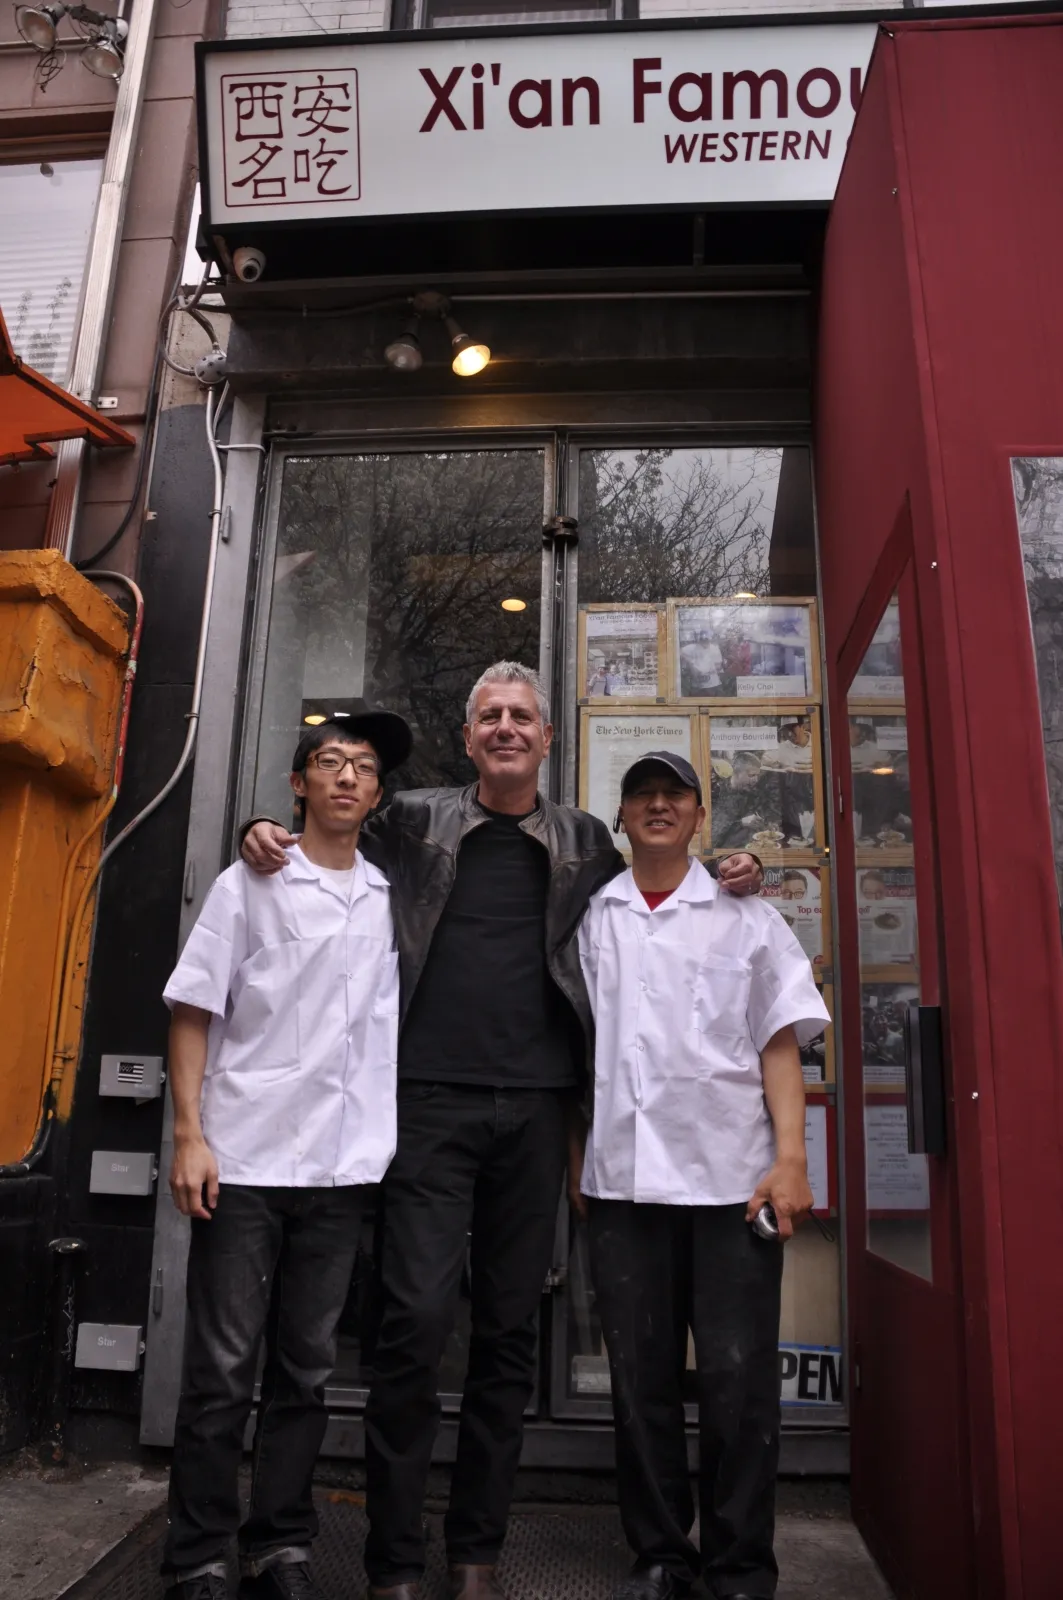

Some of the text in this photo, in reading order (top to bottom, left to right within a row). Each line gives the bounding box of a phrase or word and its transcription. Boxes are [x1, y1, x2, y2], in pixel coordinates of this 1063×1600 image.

[228, 75, 352, 142] 西安
[418, 63, 600, 132] Xi'an
[231, 138, 352, 199] 名吃
[664, 129, 832, 164] WESTERN
[595, 725, 683, 737] The New York Times
[797, 905, 812, 915] Top
[779, 1351, 841, 1403] PEN
